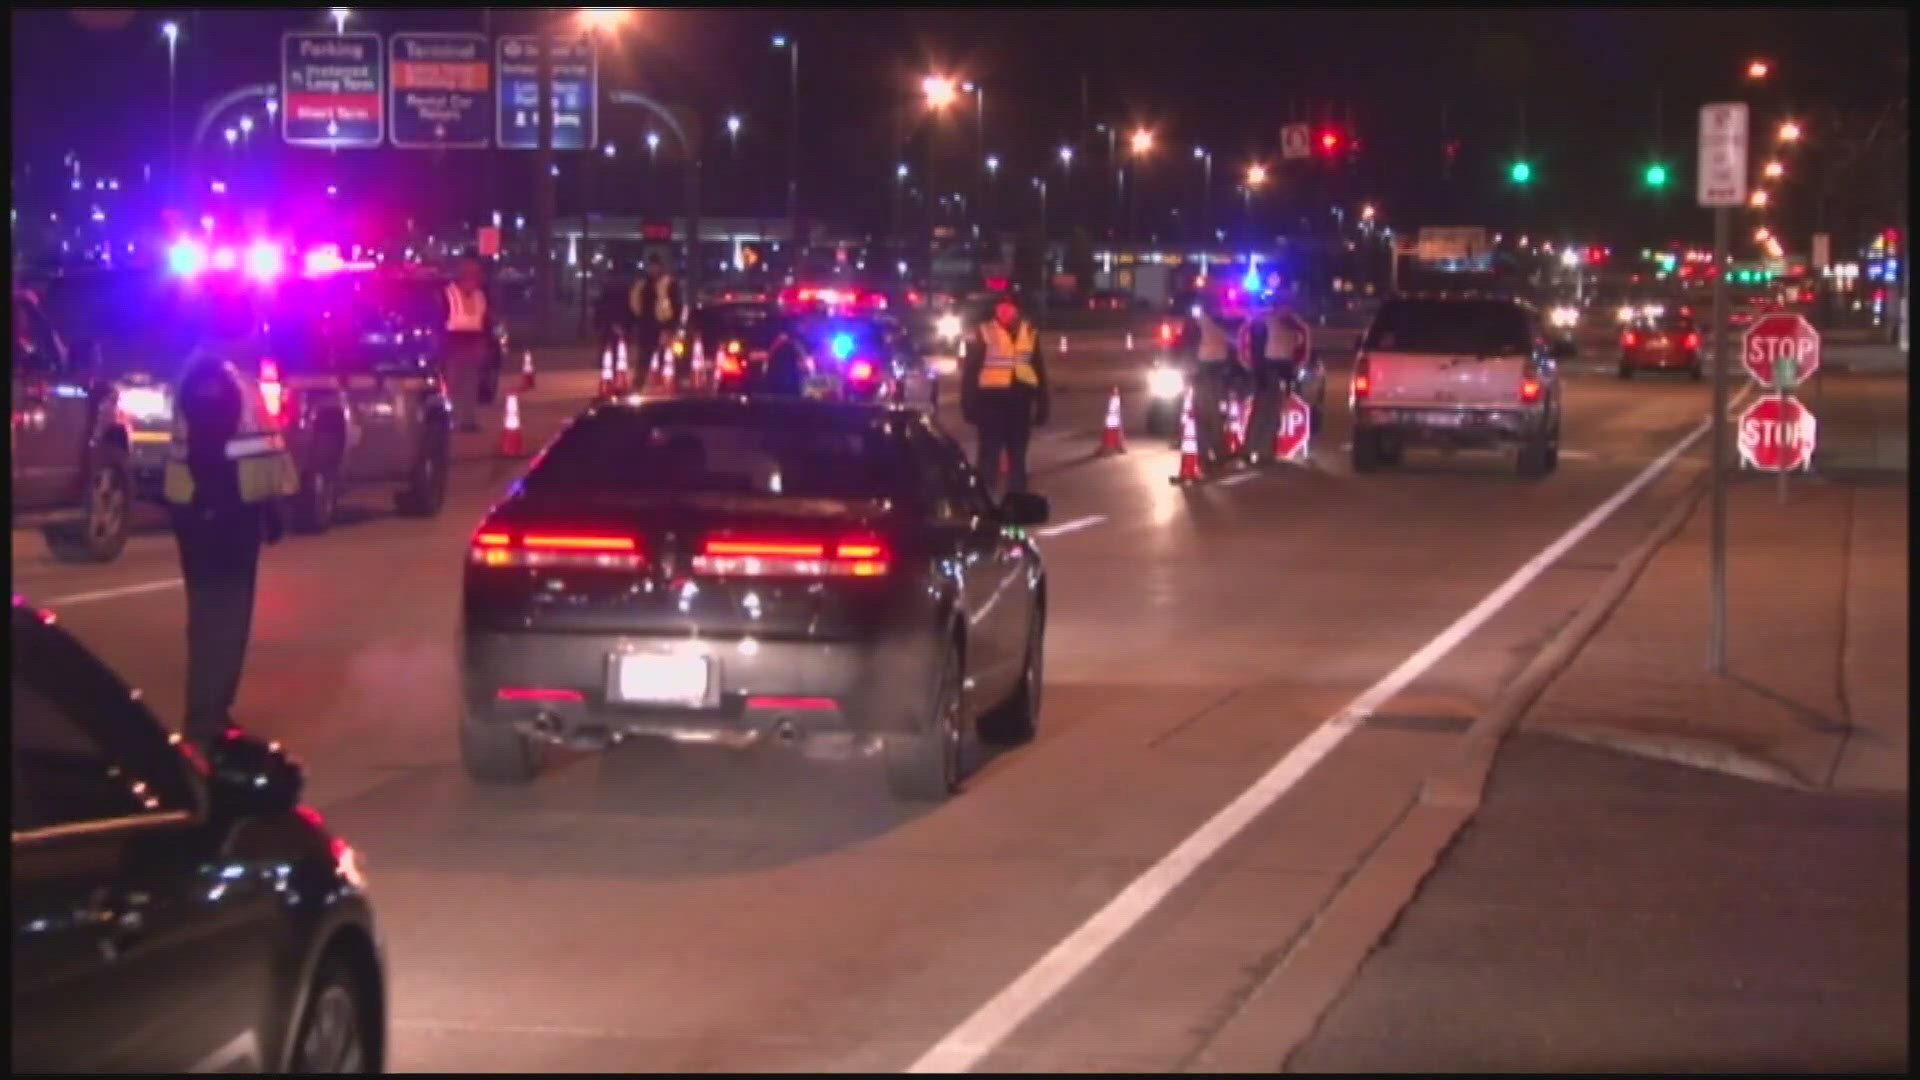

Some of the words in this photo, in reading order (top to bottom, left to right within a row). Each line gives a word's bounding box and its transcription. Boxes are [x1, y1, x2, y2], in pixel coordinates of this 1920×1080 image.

[301, 40, 363, 60] Parking
[404, 40, 475, 58] Terminal
[305, 79, 340, 94] Long
[342, 78, 375, 93] Term
[1749, 336, 1814, 363] STOP
